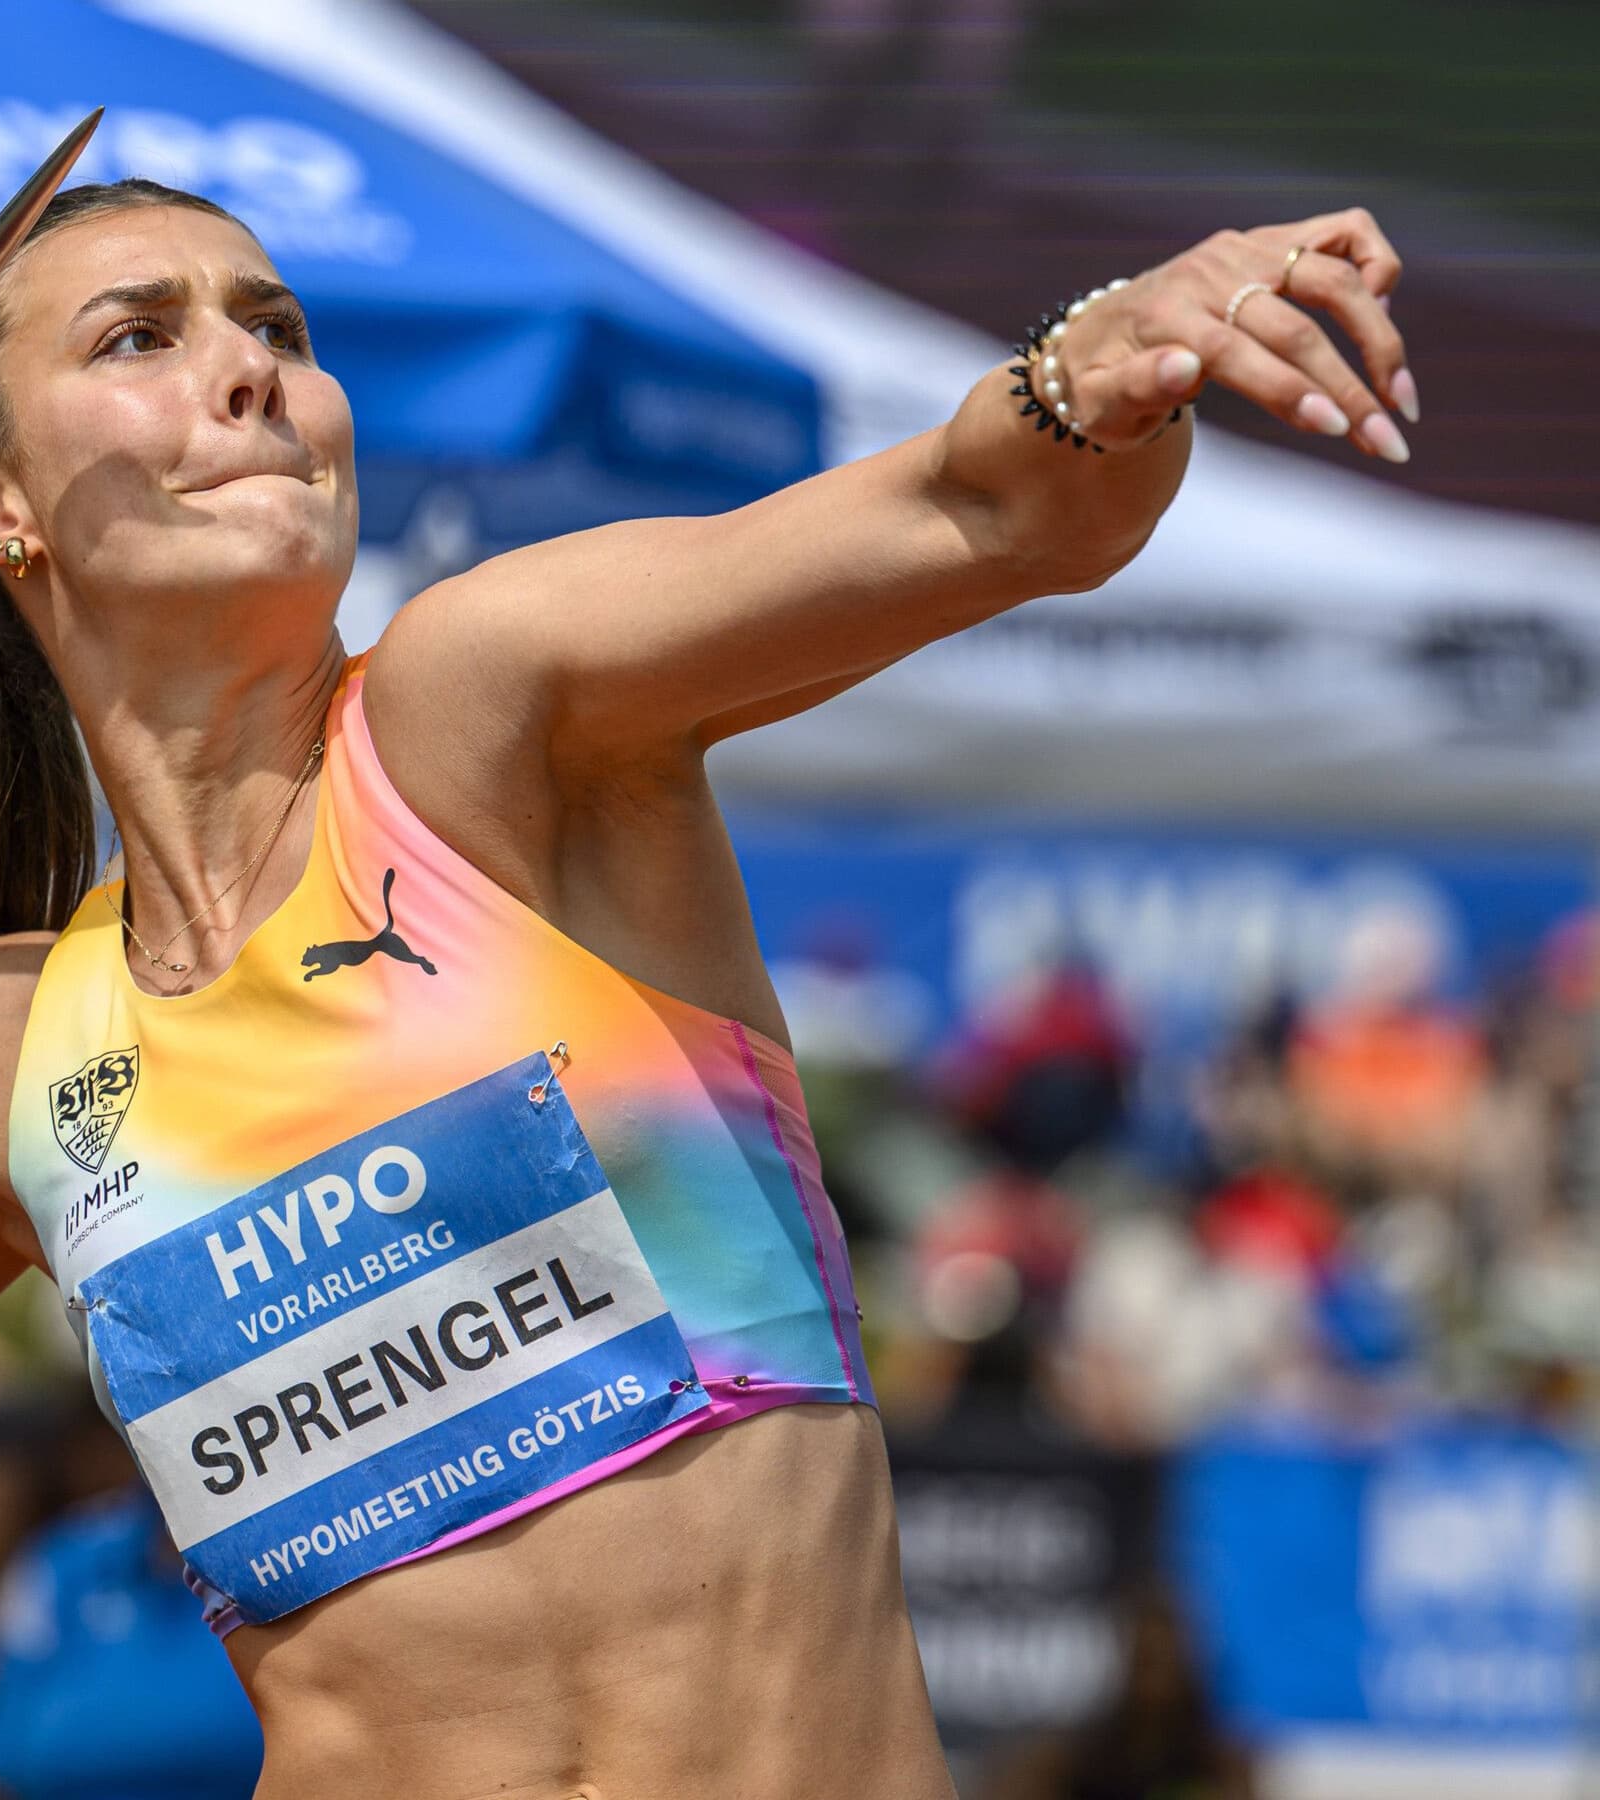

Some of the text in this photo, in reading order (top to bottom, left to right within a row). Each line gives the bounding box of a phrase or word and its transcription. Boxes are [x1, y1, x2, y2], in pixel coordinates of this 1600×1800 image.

[71, 1219, 99, 1253] PORSCHE
[101, 1193, 144, 1224] COMPANY
[83, 1160, 140, 1220] MHP
[204, 1145, 427, 1299] HYPO
[237, 1219, 456, 1344] VORARLBERG
[190, 1257, 615, 1496] SPRENGEL
[249, 1373, 647, 1588] HYPOMEETING GÖTZIS
